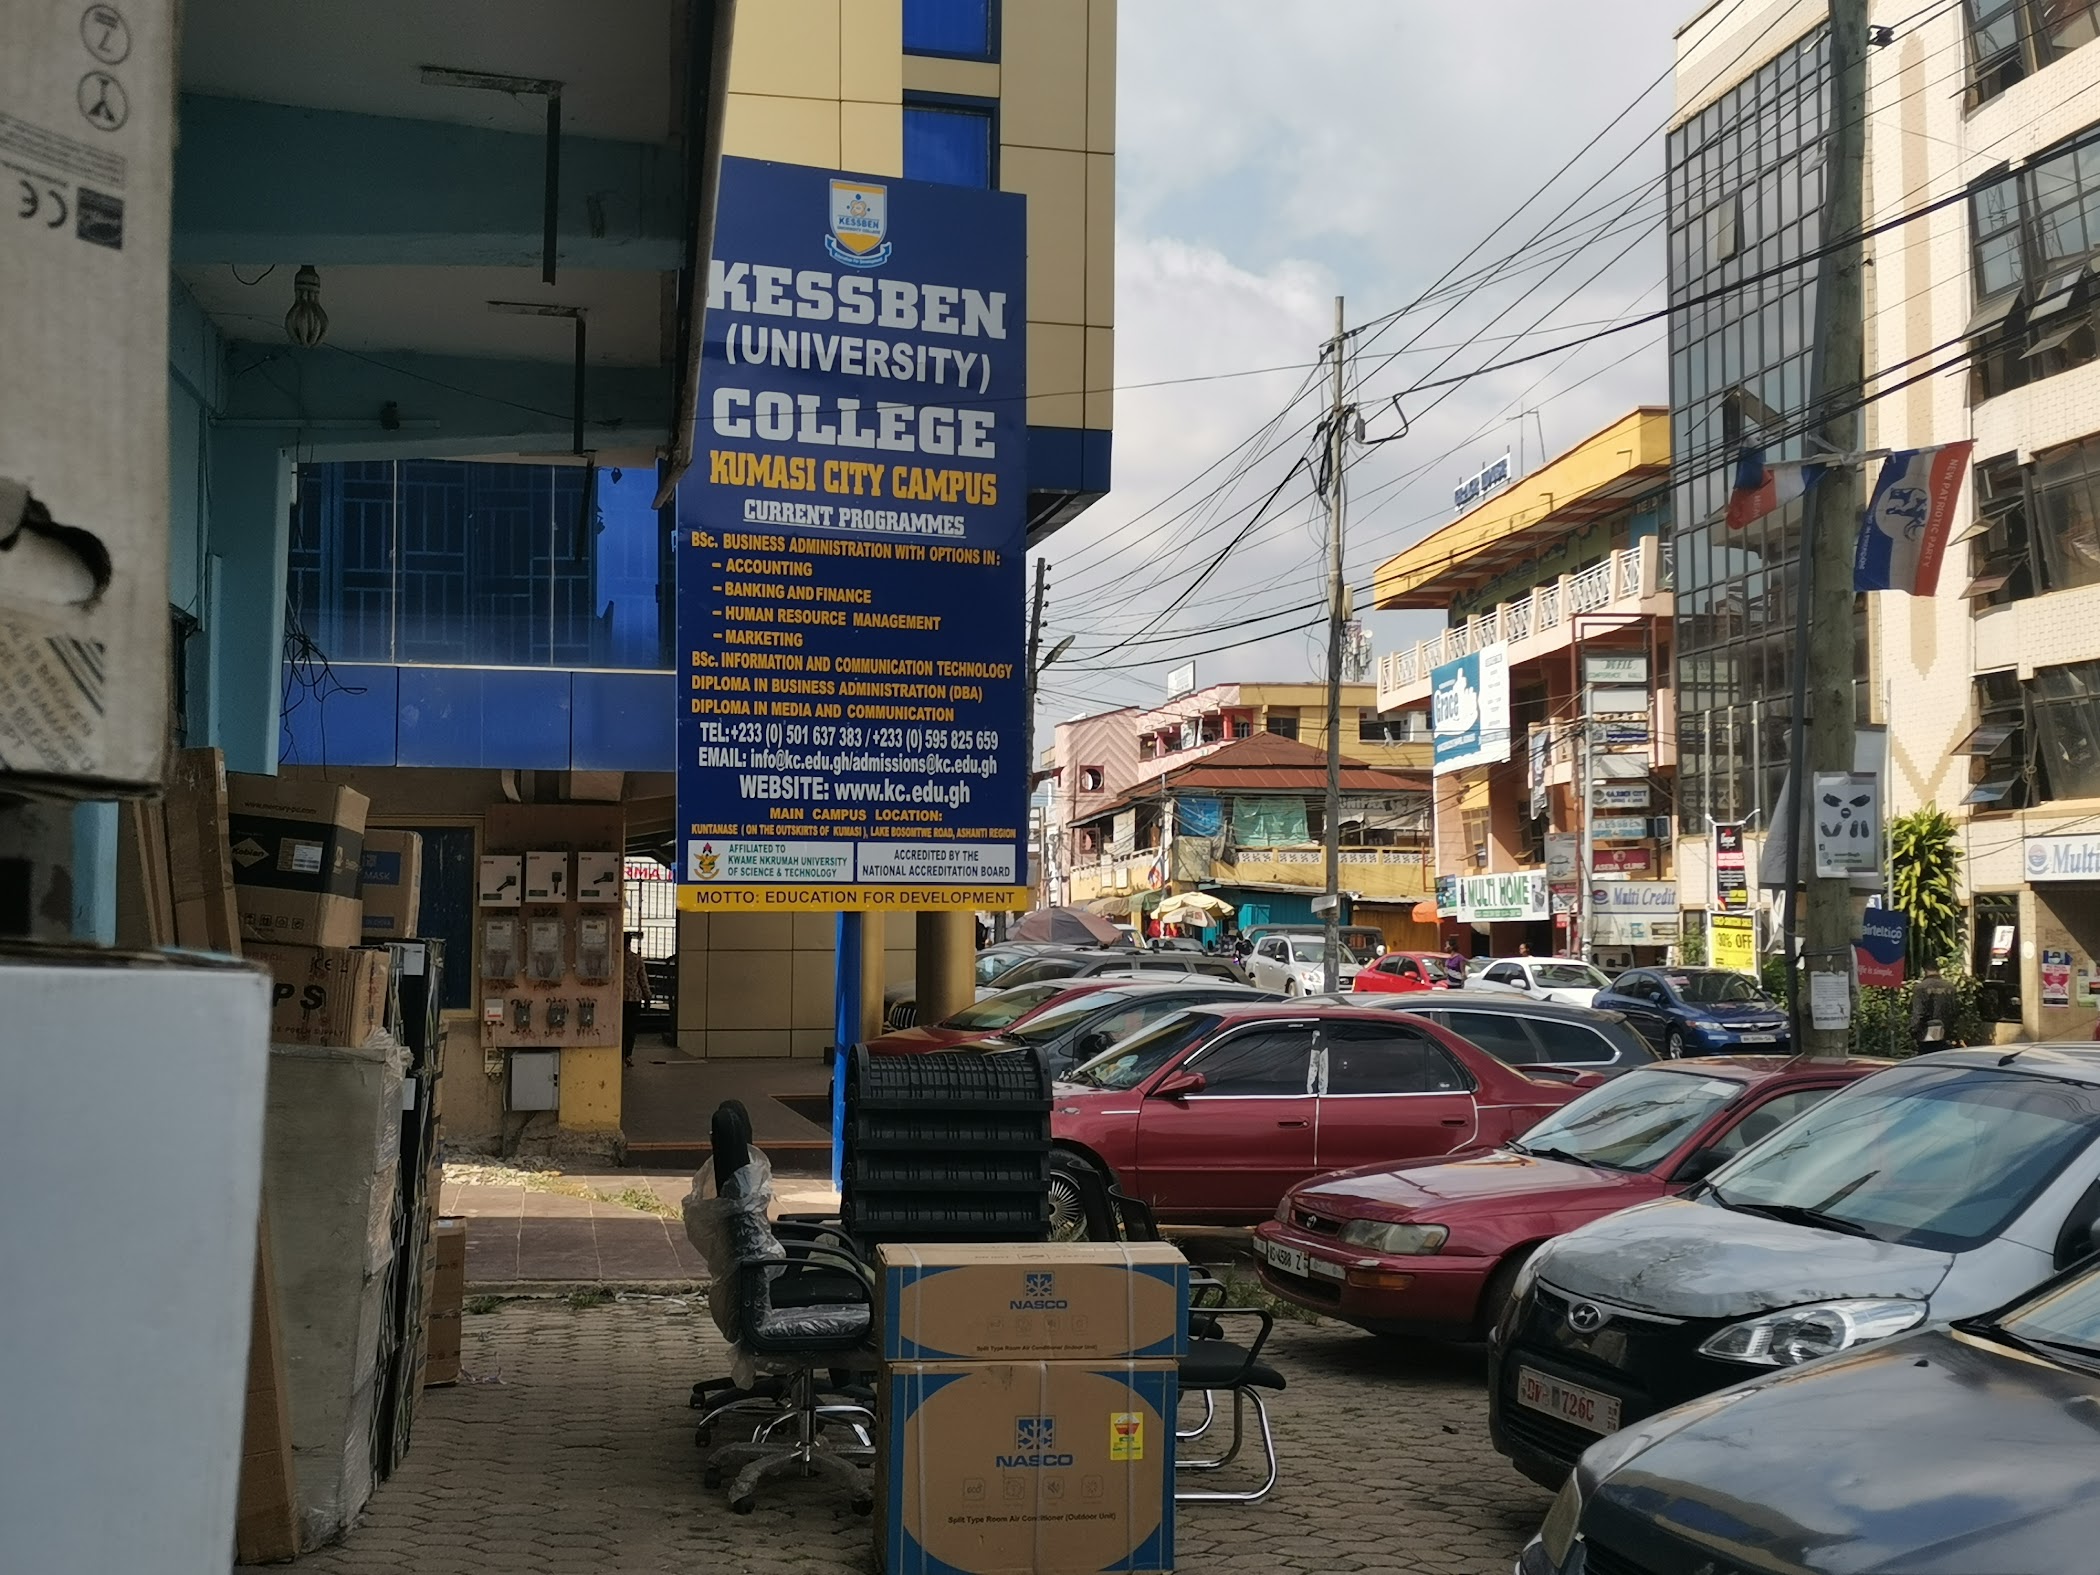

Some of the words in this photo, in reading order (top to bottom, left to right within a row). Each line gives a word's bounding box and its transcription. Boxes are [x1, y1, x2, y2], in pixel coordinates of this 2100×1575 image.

[839, 217, 879, 229] KESSBEN
[706, 259, 1006, 340] KESSBEN
[726, 322, 990, 394] (UNIVERSITY)
[712, 387, 995, 459] COLLEGE
[710, 450, 816, 491] KUMASI
[824, 458, 885, 496] CITY
[892, 466, 997, 506] CAMPUS
[1944, 458, 1959, 481] NEW
[744, 499, 833, 527] CURRENT
[839, 506, 965, 535] PROGRAMMES
[1931, 482, 1950, 534] PATRIOTIC
[691, 531, 718, 548] BSc.
[723, 533, 785, 552] BUSINESS
[789, 537, 892, 557] ADMINISTRATION
[895, 544, 925, 561] WITH
[929, 546, 980, 565] OPTIONS
[983, 550, 1000, 566] IN:
[1922, 535, 1936, 568] PARTY
[726, 558, 812, 576] ACCOUNTING
[725, 581, 785, 598] BANKING
[787, 584, 814, 600] AND
[816, 587, 872, 604] FINANCE
[725, 606, 773, 622] HUMAN
[778, 608, 846, 625] RESOURCE
[853, 612, 941, 630] MANAGEMENT
[725, 629, 803, 647] MARKETING
[692, 651, 718, 667] BSc.
[721, 652, 803, 670] INFORMATION
[806, 656, 830, 672] AND
[835, 657, 933, 675] COMMUNICATION
[937, 661, 1013, 679] TECHNOLOGY
[691, 675, 750, 691] DIPLOMA
[754, 677, 768, 692] IN
[772, 678, 835, 695] BUSINESS
[839, 681, 946, 699] ADMINISTRATION
[949, 685, 983, 703] (DBA)
[691, 699, 750, 715] DIPLOMA
[754, 701, 767, 715] IN
[771, 701, 812, 717] MEDIA
[815, 703, 841, 718] AND
[847, 704, 954, 721] COMMUNICATION
[1436, 692, 1459, 723] Grace
[766, 723, 783, 748] (0)
[786, 725, 808, 745] 501
[812, 726, 836, 746] 637
[839, 727, 862, 747] 383
[873, 728, 902, 748] +233
[906, 729, 922, 753] (0)
[925, 729, 947, 749] 595
[951, 730, 973, 750] 825
[976, 731, 998, 750] 659
[699, 747, 747, 768] EMAIL:
[751, 748, 997, 778] info@kc.edu.gh/admissions@kc.edu.gh
[740, 775, 829, 800] WEBSITE:
[834, 778, 970, 808] www.kc.edu.gh
[770, 807, 804, 820] MAIN
[812, 808, 866, 821] CAMPUS
[875, 809, 943, 821] LOCATION:
[691, 823, 738, 835] KUNTANASE
[746, 824, 757, 835] ON
[759, 824, 775, 835] THE
[776, 824, 817, 836] OUTSKIRTS
[820, 826, 830, 837] OF
[870, 826, 889, 837] LAKE
[956, 828, 987, 838] ASHANTI
[989, 828, 1016, 839] REGION
[729, 844, 773, 853] AFFILIATED
[775, 844, 786, 853] TO
[894, 850, 946, 861] ACCREDITED
[949, 850, 960, 861] BY
[963, 851, 979, 861] THE
[728, 856, 757, 865] KWAME
[759, 856, 799, 865] NKRUMAH
[801, 857, 848, 867] UNIVERSITY
[728, 867, 738, 876] OF
[740, 867, 774, 877] SCIENCE
[776, 868, 782, 877] &
[784, 868, 837, 878] TECHNOLOGY
[862, 865, 906, 877] NATIONAL
[909, 866, 978, 877] ACCREDITATION
[981, 866, 1010, 877] BOARD
[697, 891, 759, 904] MOTTO:
[765, 891, 857, 903] EDUCATION
[863, 891, 895, 904] FOR
[900, 891, 1015, 904] DEVELOPMENT
[1468, 878, 1495, 907] MULTI
[1499, 876, 1530, 906] HOME
[1613, 888, 1638, 906] Multi
[1642, 888, 1676, 905] Credit
[1735, 934, 1753, 949] OFF
[1010, 1300, 1068, 1310] NASCO
[996, 1454, 1073, 1467] NASCO
[948, 1516, 965, 1524] Split
[966, 1516, 984, 1524] Type
[1065, 1513, 1097, 1522] (Outdoor
[1099, 1512, 1116, 1521] Unit)
